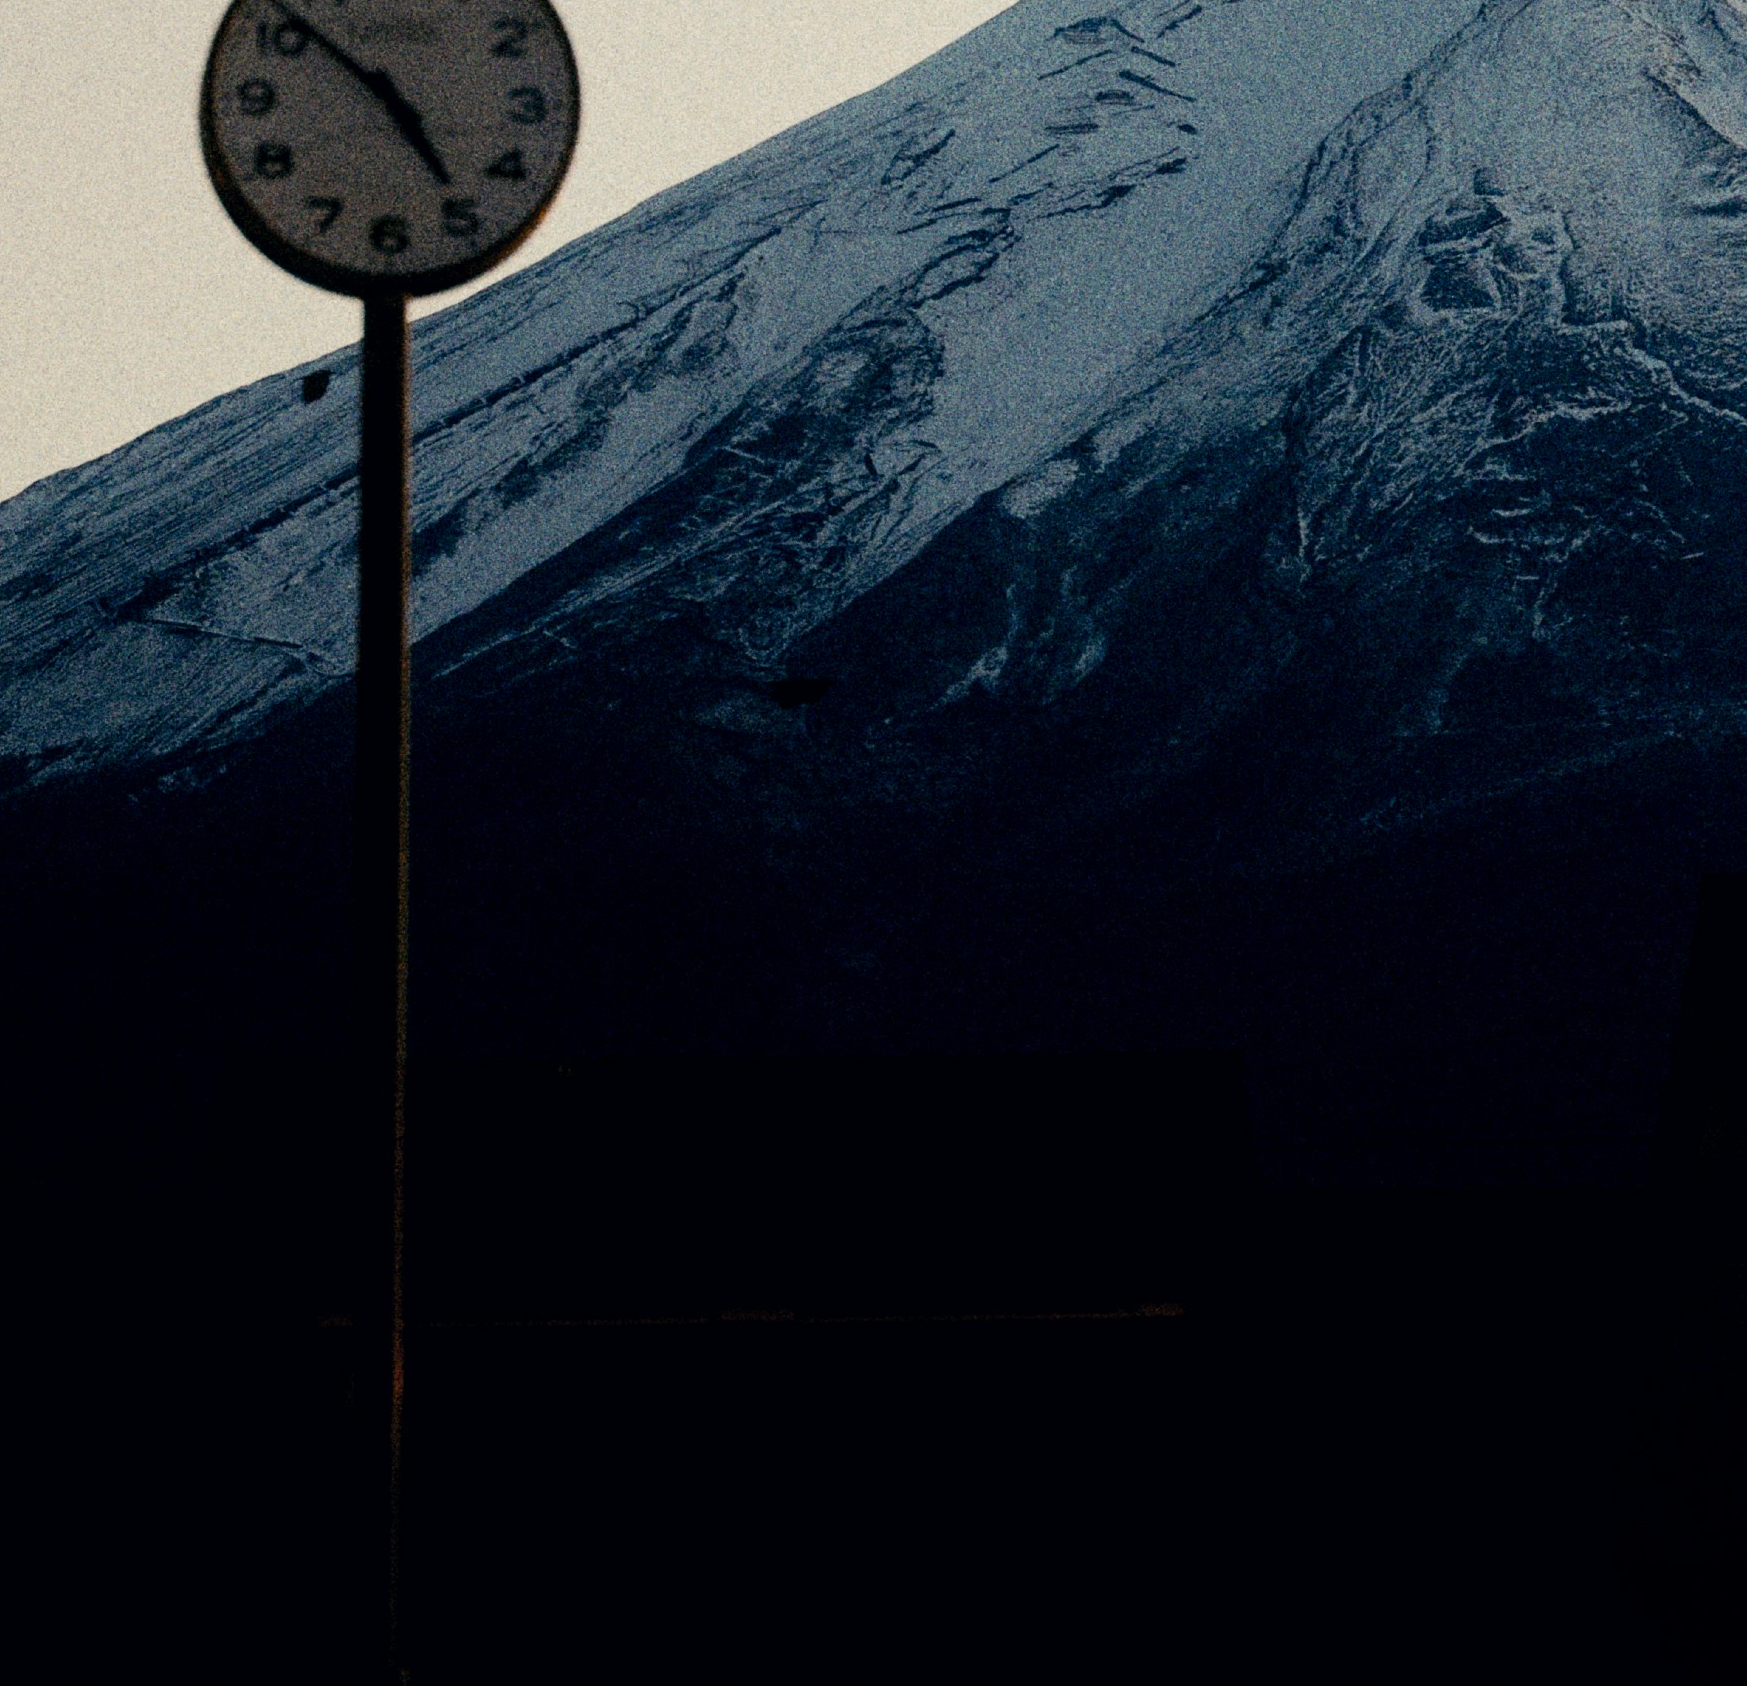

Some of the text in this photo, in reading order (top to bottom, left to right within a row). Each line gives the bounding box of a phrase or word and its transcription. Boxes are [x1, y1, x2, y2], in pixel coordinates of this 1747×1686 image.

[258, 22, 309, 57] 10
[492, 20, 527, 57] 2
[238, 78, 276, 116] 9
[507, 86, 546, 124] 3
[255, 143, 295, 179] 8
[486, 148, 527, 181] 4
[308, 196, 342, 233] 7
[442, 198, 479, 238] 5
[370, 216, 408, 255] 6
